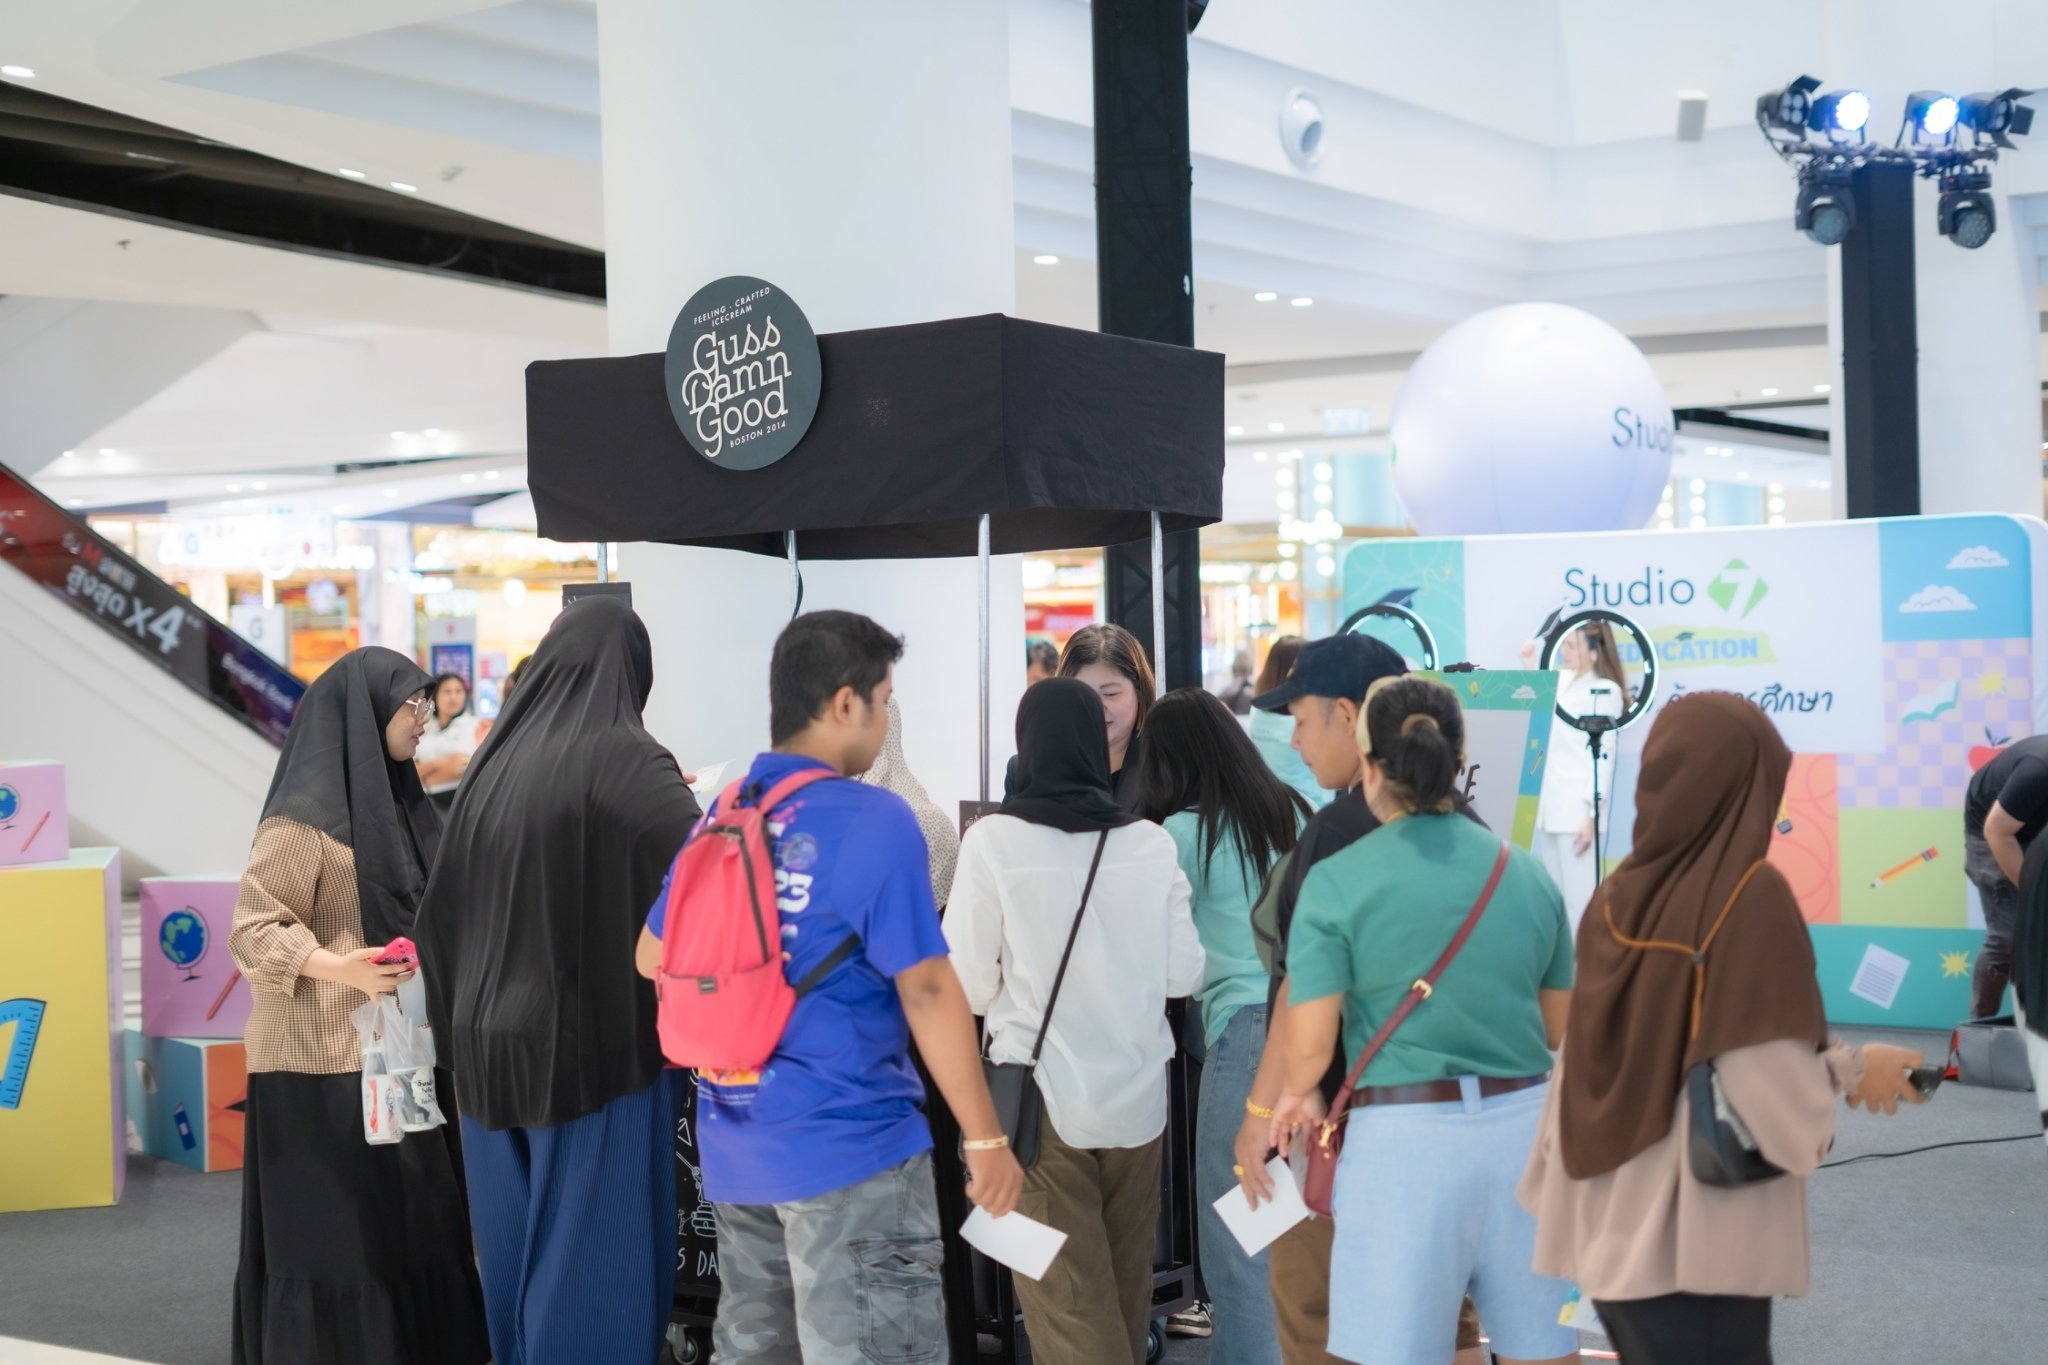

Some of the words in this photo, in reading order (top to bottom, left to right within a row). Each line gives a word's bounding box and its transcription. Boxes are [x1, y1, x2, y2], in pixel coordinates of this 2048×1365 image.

[694, 305, 726, 325] FEELING
[734, 287, 770, 307] CRAFTED
[711, 304, 753, 327] ICECREAM
[693, 315, 781, 388] Guss
[682, 351, 792, 415] Damn
[696, 375, 788, 457] Good
[730, 429, 763, 448] BOSTON
[766, 420, 786, 434] 2014
[1565, 566, 1695, 607] Studio
